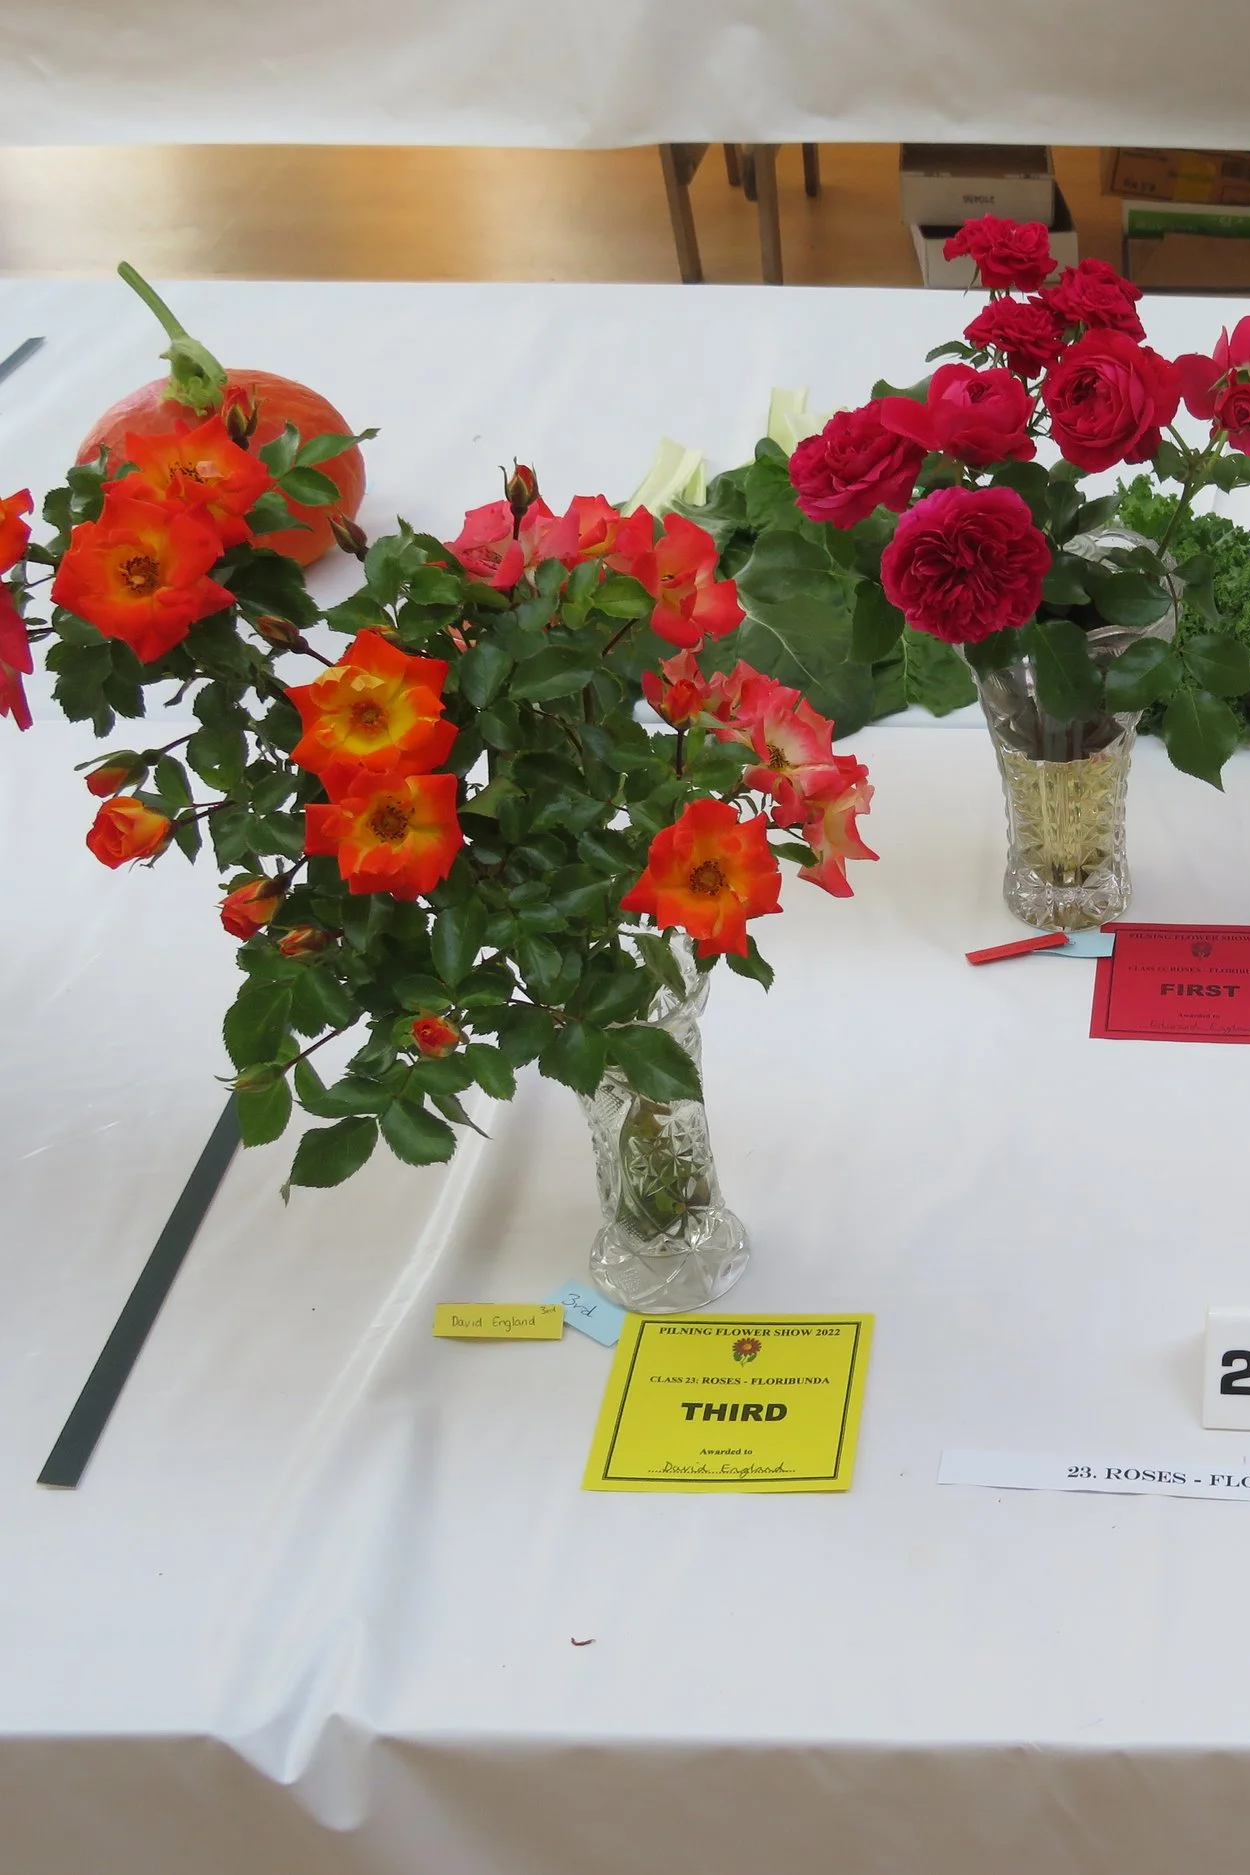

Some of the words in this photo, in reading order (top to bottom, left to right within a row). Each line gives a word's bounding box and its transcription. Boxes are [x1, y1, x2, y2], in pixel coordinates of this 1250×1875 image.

[1175, 933, 1220, 941] FLOWER
[1160, 983, 1240, 998] FIRST
[540, 1306, 557, 1315] 3rd
[561, 1293, 598, 1318] 3rd
[452, 1315, 483, 1328] David
[492, 1315, 536, 1332] England
[659, 1327, 713, 1336] PILNING
[715, 1328, 771, 1337] FLOWER
[773, 1329, 813, 1337] SHOW
[815, 1328, 841, 1336] 2022
[650, 1376, 683, 1384] CLASS
[702, 1377, 741, 1385] ROSES
[751, 1377, 830, 1385] FLORIBUNDA
[680, 1402, 788, 1422] THIRD
[699, 1448, 742, 1456] Awarded
[743, 1448, 753, 1456] to
[662, 1461, 710, 1474] David
[720, 1462, 790, 1479] England
[1067, 1465, 1097, 1479] 23.
[1104, 1467, 1187, 1484] ROSES
